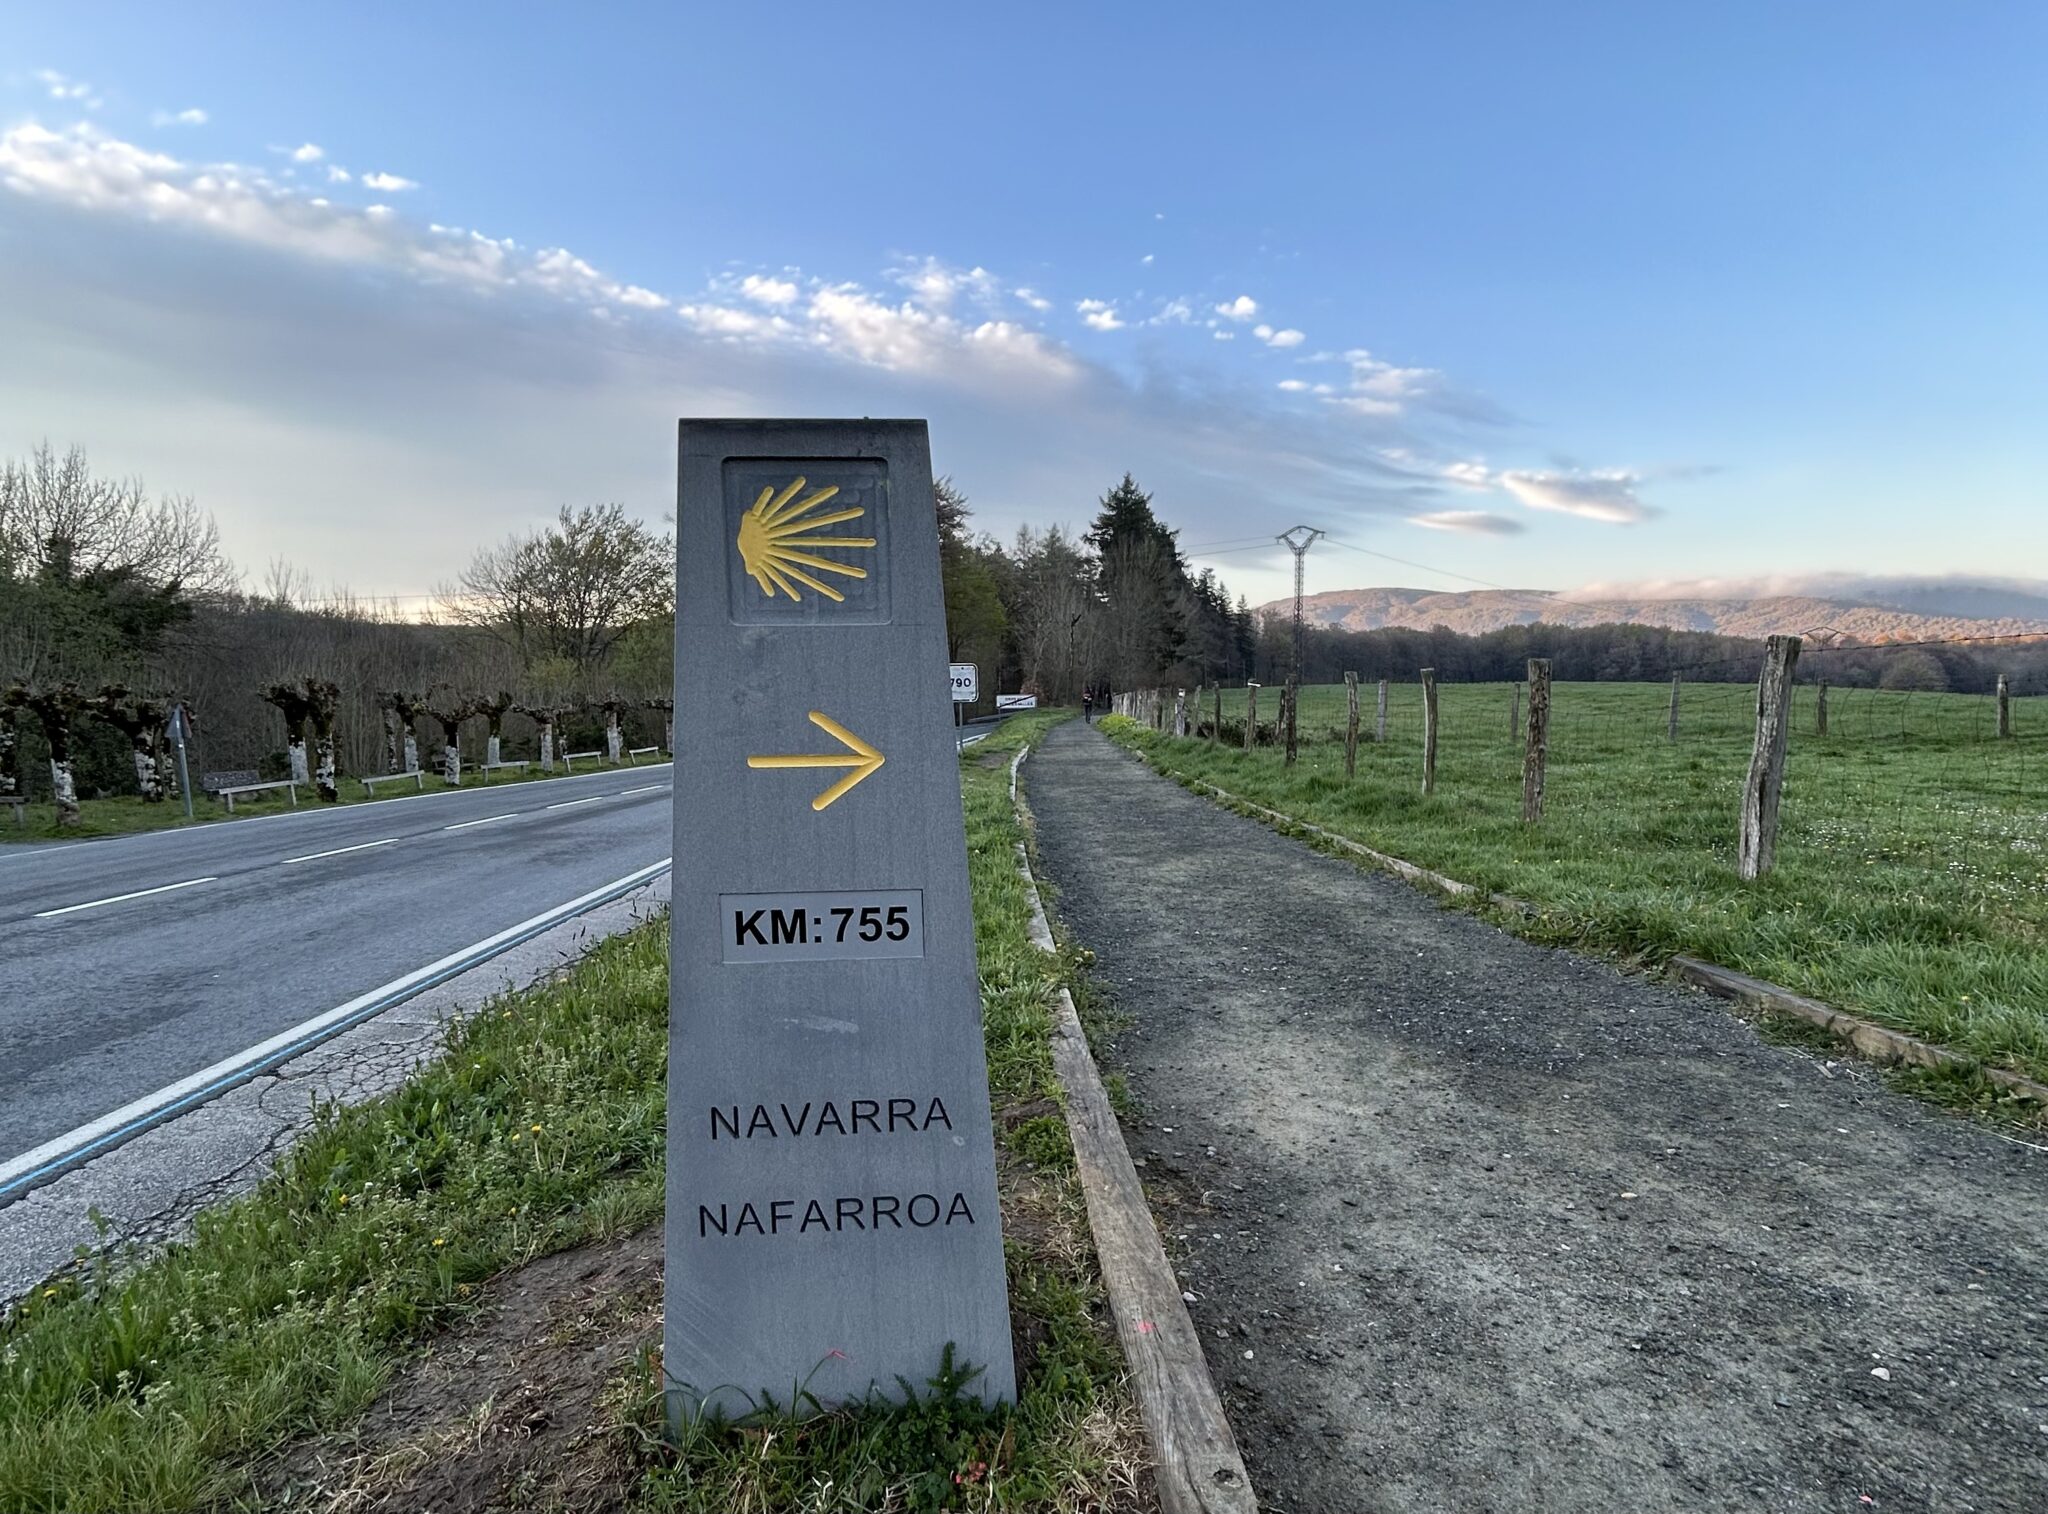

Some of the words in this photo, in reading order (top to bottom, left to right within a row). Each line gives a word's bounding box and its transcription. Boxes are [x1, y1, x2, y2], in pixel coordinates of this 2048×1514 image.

[734, 906, 910, 946] KM:755
[710, 1096, 953, 1140] NAVARRA
[699, 1192, 975, 1238] NAFARROA
